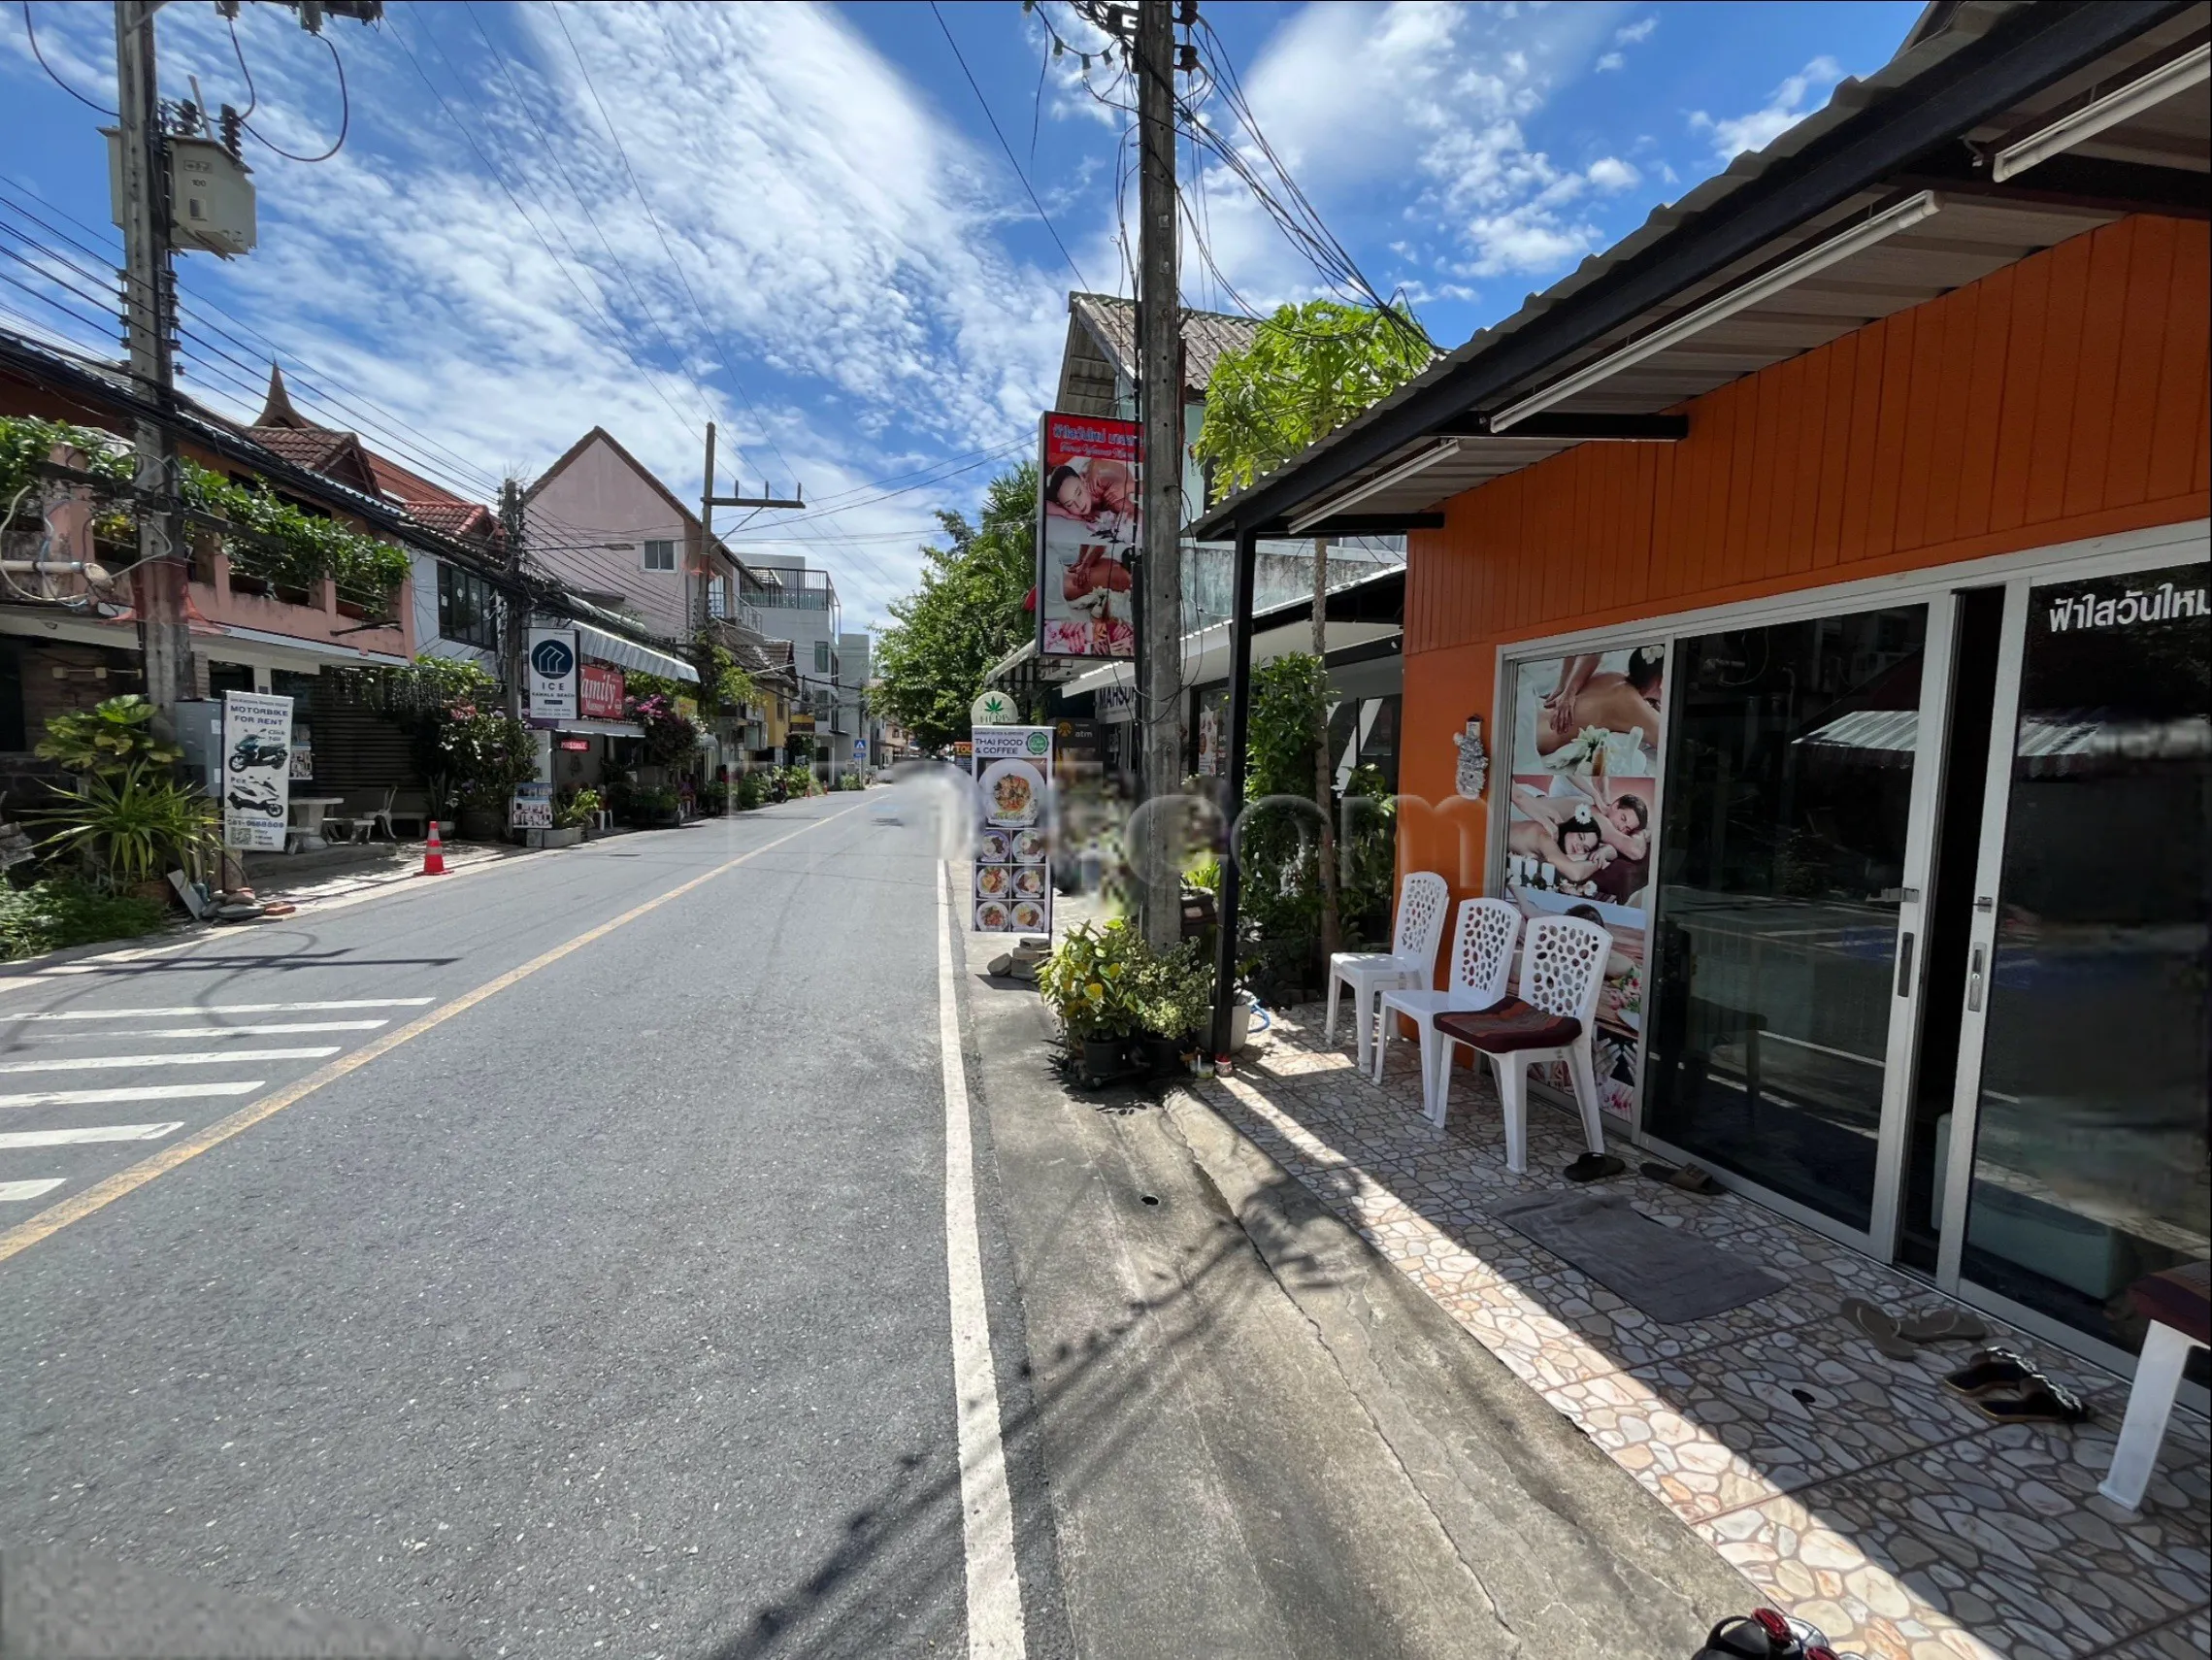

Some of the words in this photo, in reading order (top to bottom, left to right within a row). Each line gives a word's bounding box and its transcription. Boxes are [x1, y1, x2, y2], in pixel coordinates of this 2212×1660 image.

[542, 681, 565, 691] ICE
[230, 706, 289, 716] MOTORBIKE
[234, 714, 255, 724] FOR
[257, 717, 283, 726] RENT
[974, 738, 996, 747] THAI
